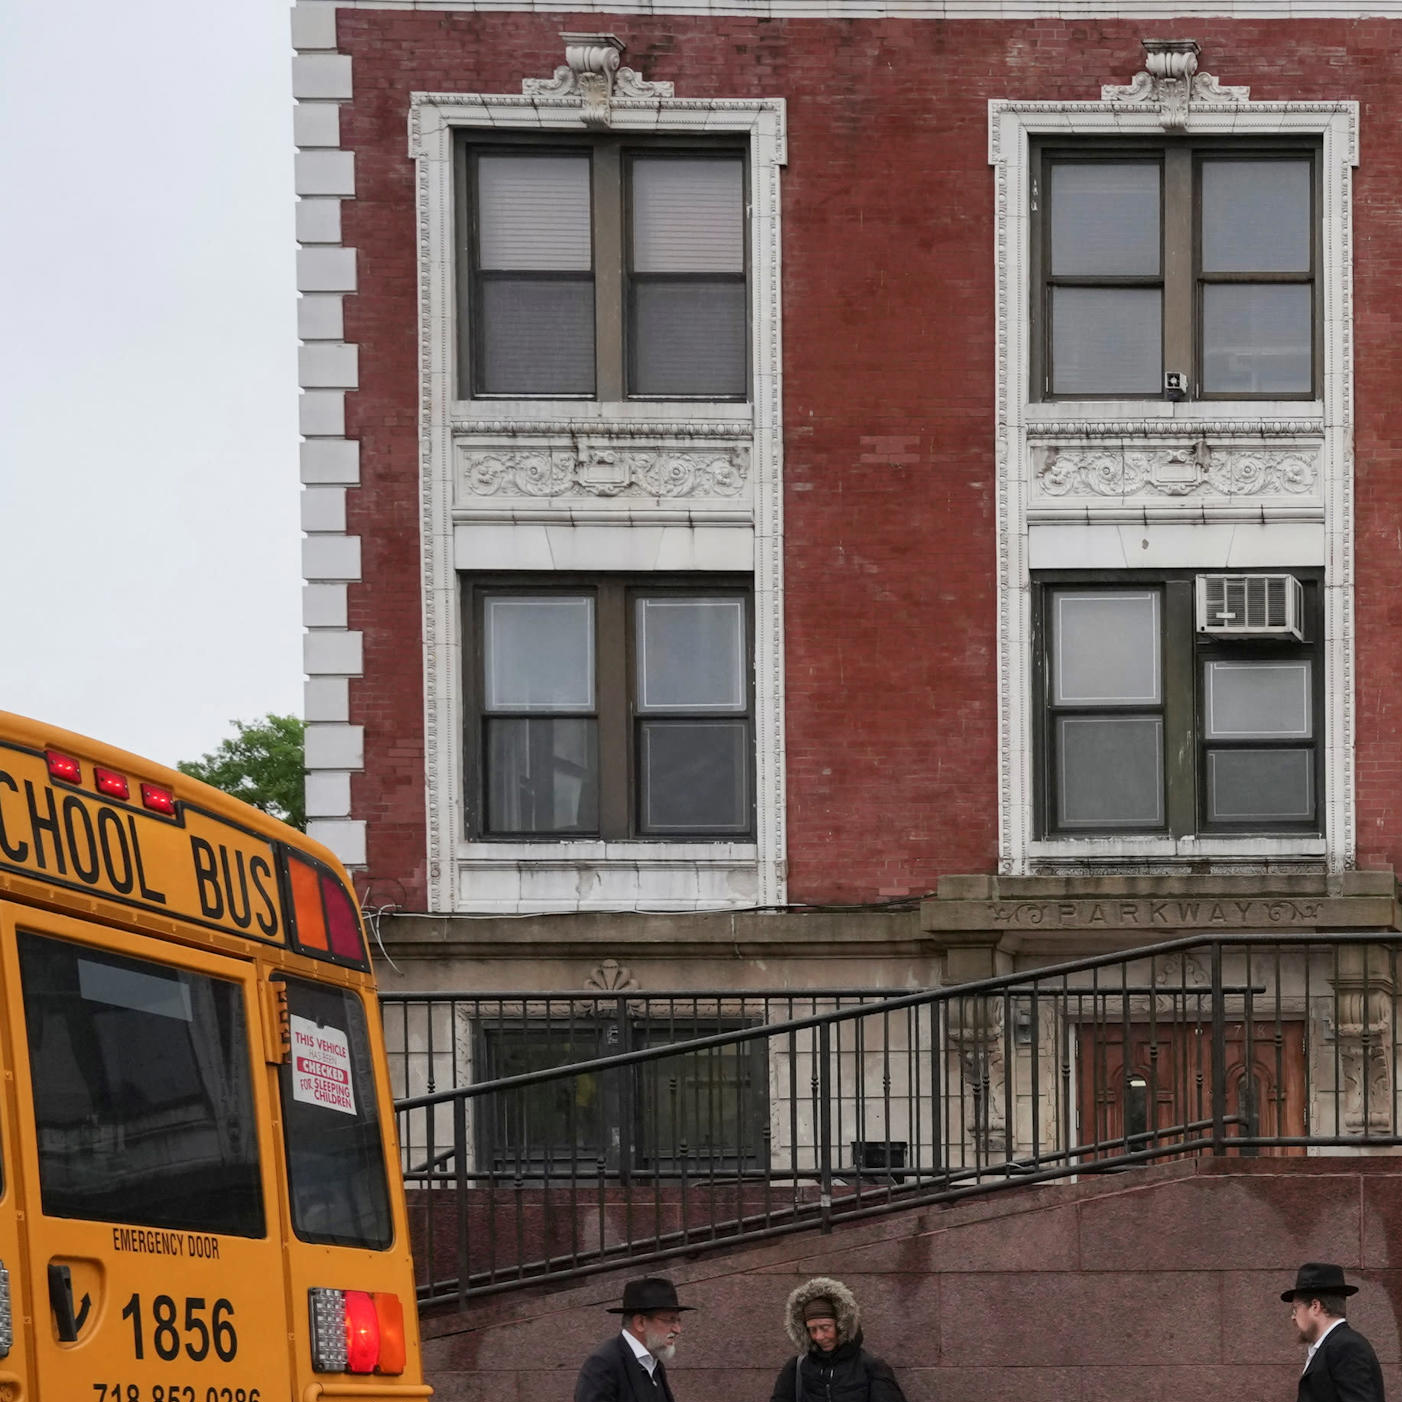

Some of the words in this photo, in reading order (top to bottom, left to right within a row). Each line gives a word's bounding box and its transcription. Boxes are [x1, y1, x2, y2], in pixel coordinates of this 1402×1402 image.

[0, 770, 166, 905] CHOOL
[190, 835, 278, 937] BUS
[1058, 902, 1254, 924] PARKWAY
[295, 1032, 314, 1047] THIS
[317, 1039, 346, 1058] VEHICLE
[303, 1059, 344, 1081] CHECKED
[300, 1079, 315, 1091] FOR
[314, 1078, 350, 1098] SLEEPING
[314, 1090, 352, 1109] CHILDREN
[112, 1228, 184, 1258] EMERGENCY
[188, 1234, 220, 1260] DOOR
[122, 1292, 238, 1363] 1856
